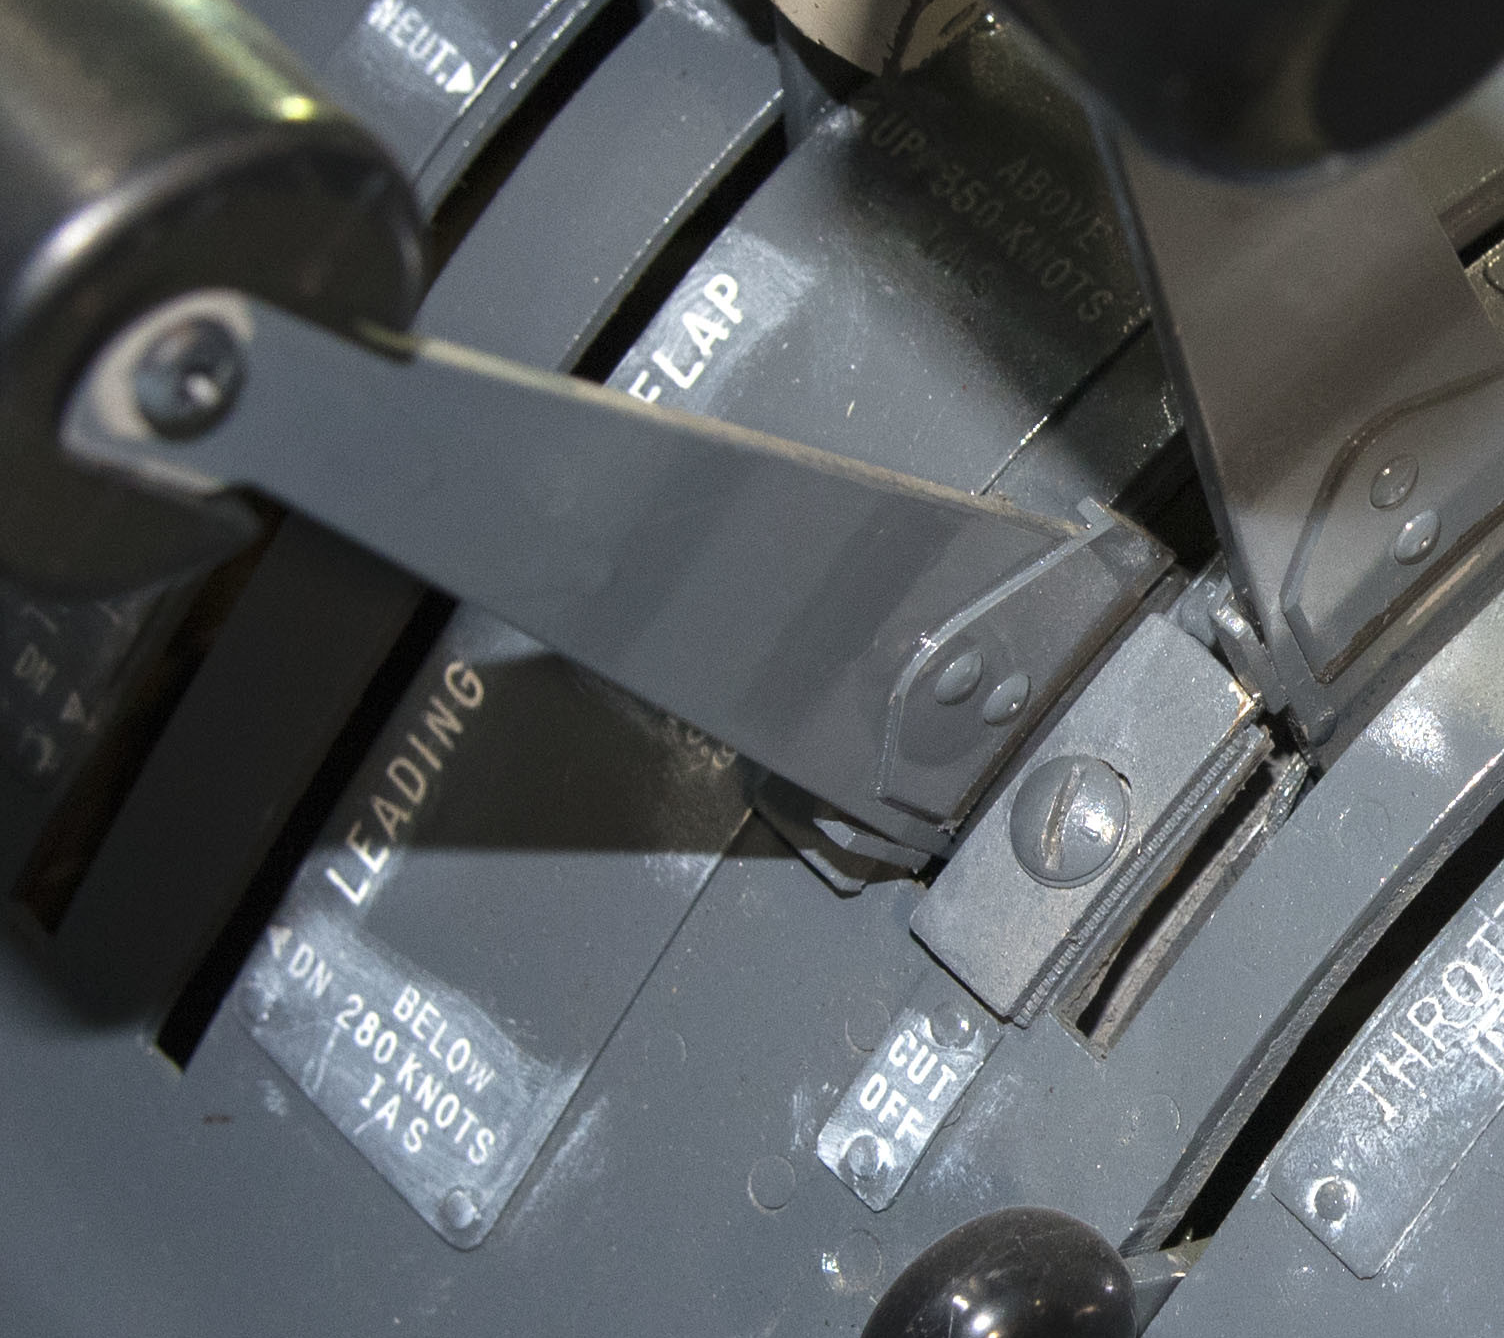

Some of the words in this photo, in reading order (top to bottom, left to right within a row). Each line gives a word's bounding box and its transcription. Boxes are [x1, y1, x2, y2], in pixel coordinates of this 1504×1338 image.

[325, 660, 485, 907] LEADING
[288, 942, 334, 998] DN
[336, 993, 399, 1063] 280
[395, 1051, 496, 1166] KNOTS
[393, 984, 497, 1095] BELOW
[888, 1029, 958, 1102] CUT
[859, 1073, 925, 1140] OFF
